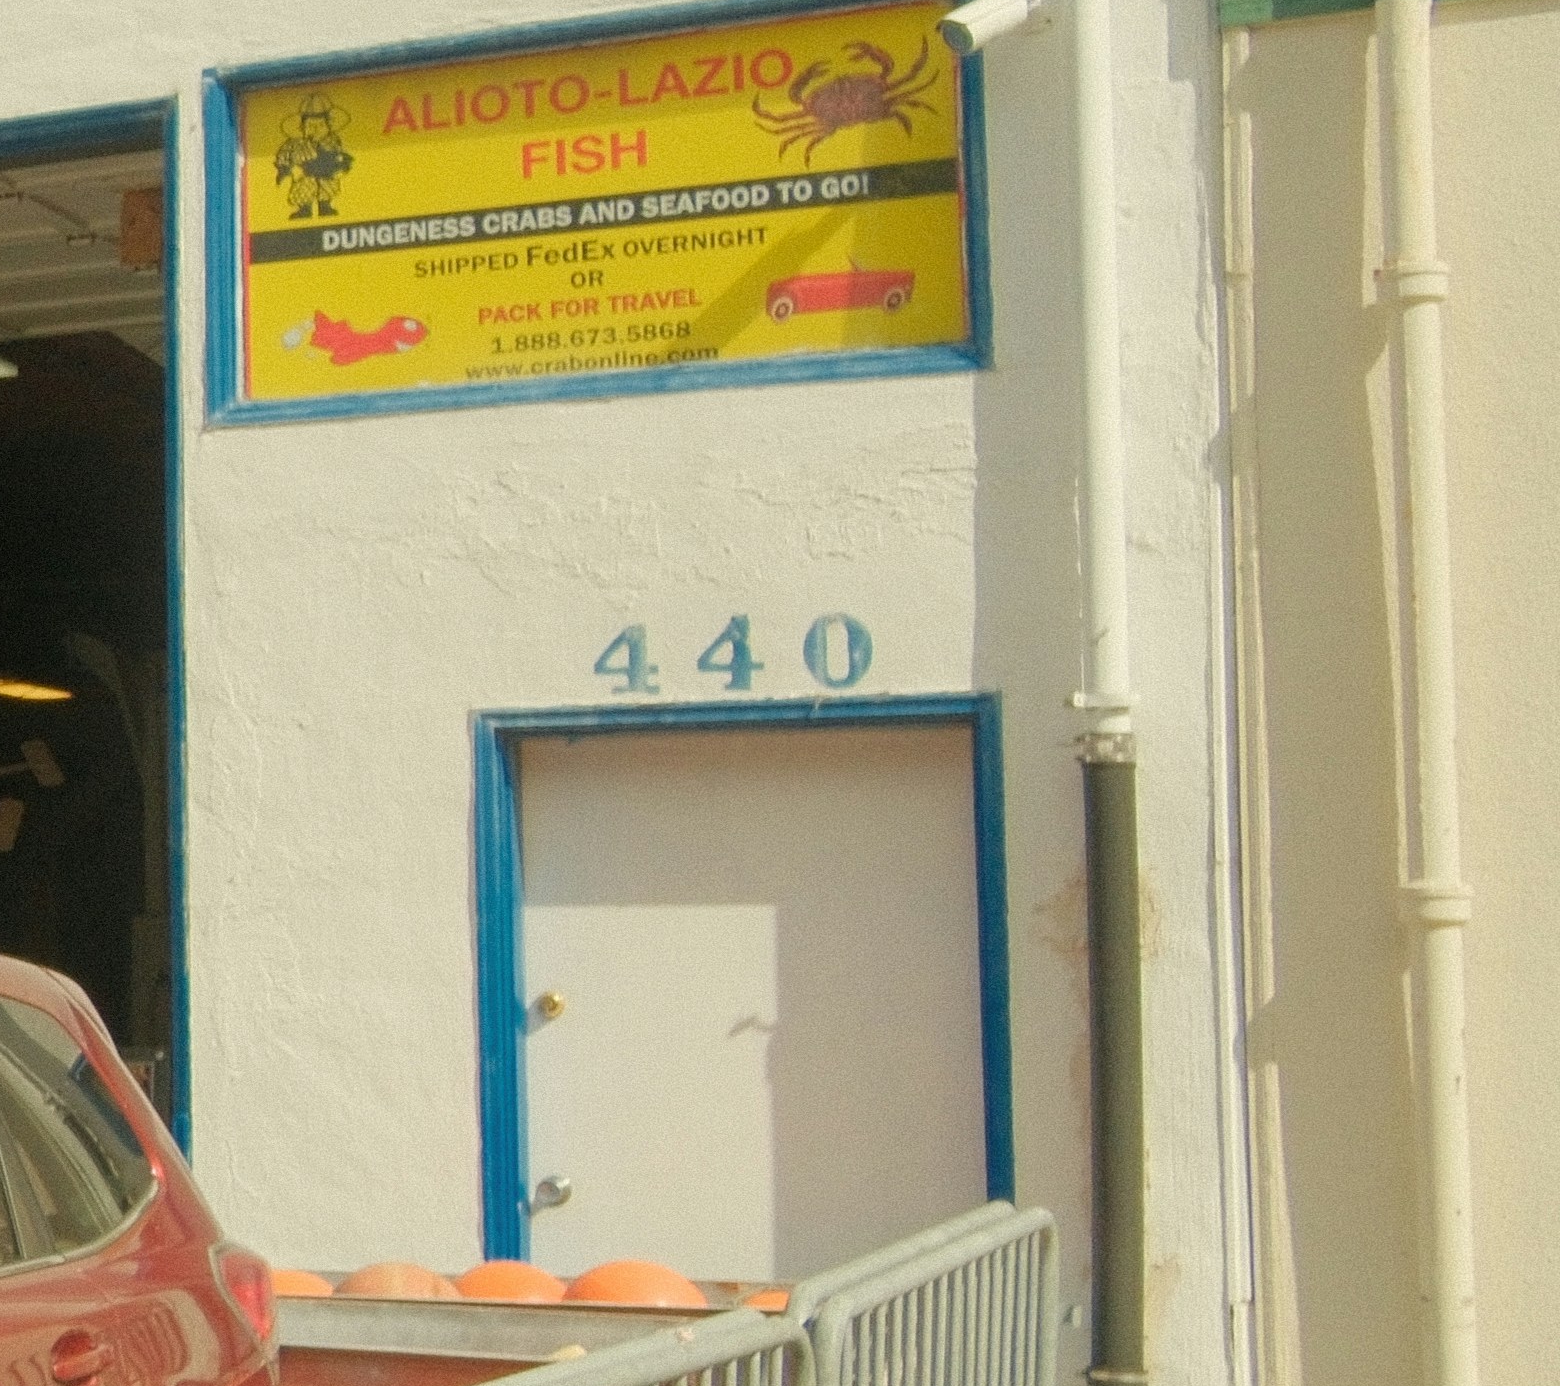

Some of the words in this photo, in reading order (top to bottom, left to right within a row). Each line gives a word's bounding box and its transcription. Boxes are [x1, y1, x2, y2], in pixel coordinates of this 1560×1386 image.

[382, 48, 793, 135] ALIOTO-LAZIO
[521, 129, 648, 179] FISH
[322, 217, 476, 252] DUNGENESS
[482, 207, 574, 235] CRABS
[578, 201, 635, 226] AND
[641, 187, 770, 219] SEAFOOD
[775, 181, 813, 205] TO
[820, 174, 870, 200] GO!
[414, 252, 519, 279] SHIPPED
[526, 238, 615, 267] FedEx
[623, 226, 767, 258] OVERNIGHT
[570, 270, 604, 289] OR
[478, 303, 542, 325] PACK
[550, 297, 599, 319] FOR
[607, 287, 703, 315] TRAVEL
[490, 321, 692, 355] 1.888.673.5868
[593, 613, 873, 695] 440
